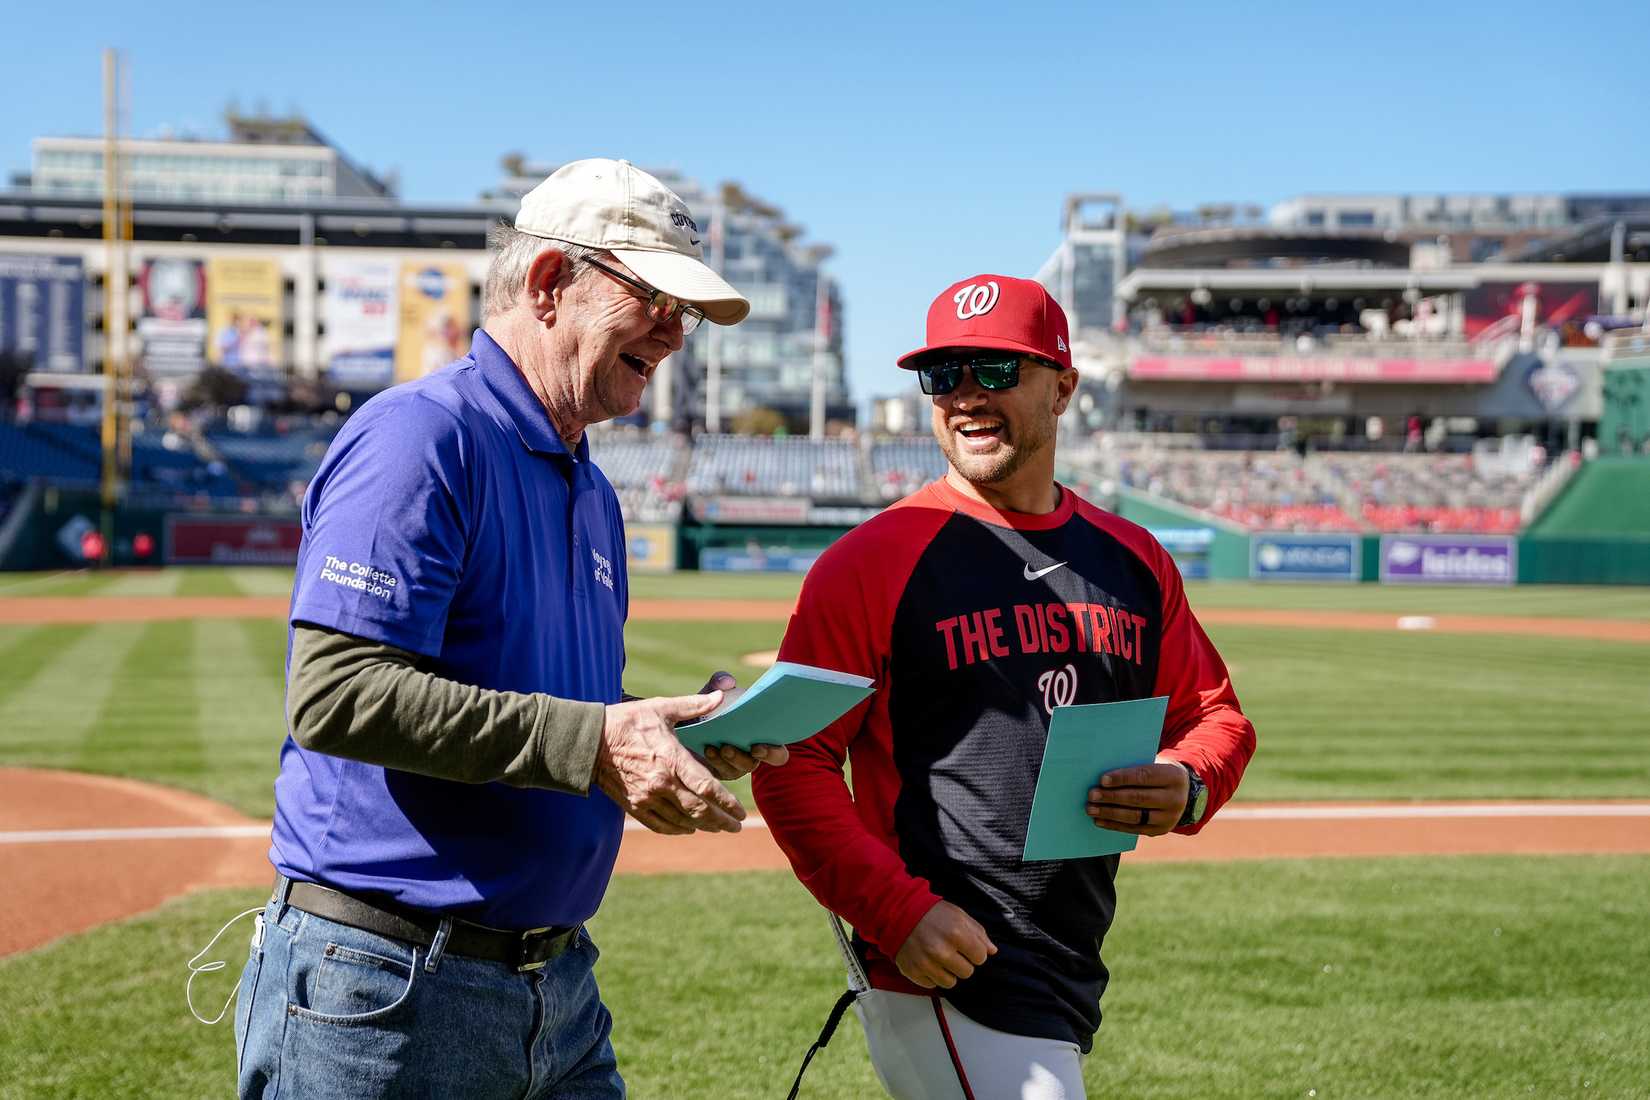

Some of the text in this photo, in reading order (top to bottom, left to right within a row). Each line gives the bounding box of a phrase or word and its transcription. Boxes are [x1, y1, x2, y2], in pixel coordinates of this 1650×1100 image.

[953, 281, 1000, 320] W
[320, 567, 391, 599] Foundation
[325, 555, 397, 587] The Collette
[935, 602, 1147, 671] THE DISTRICT
[1038, 663, 1077, 716] W
